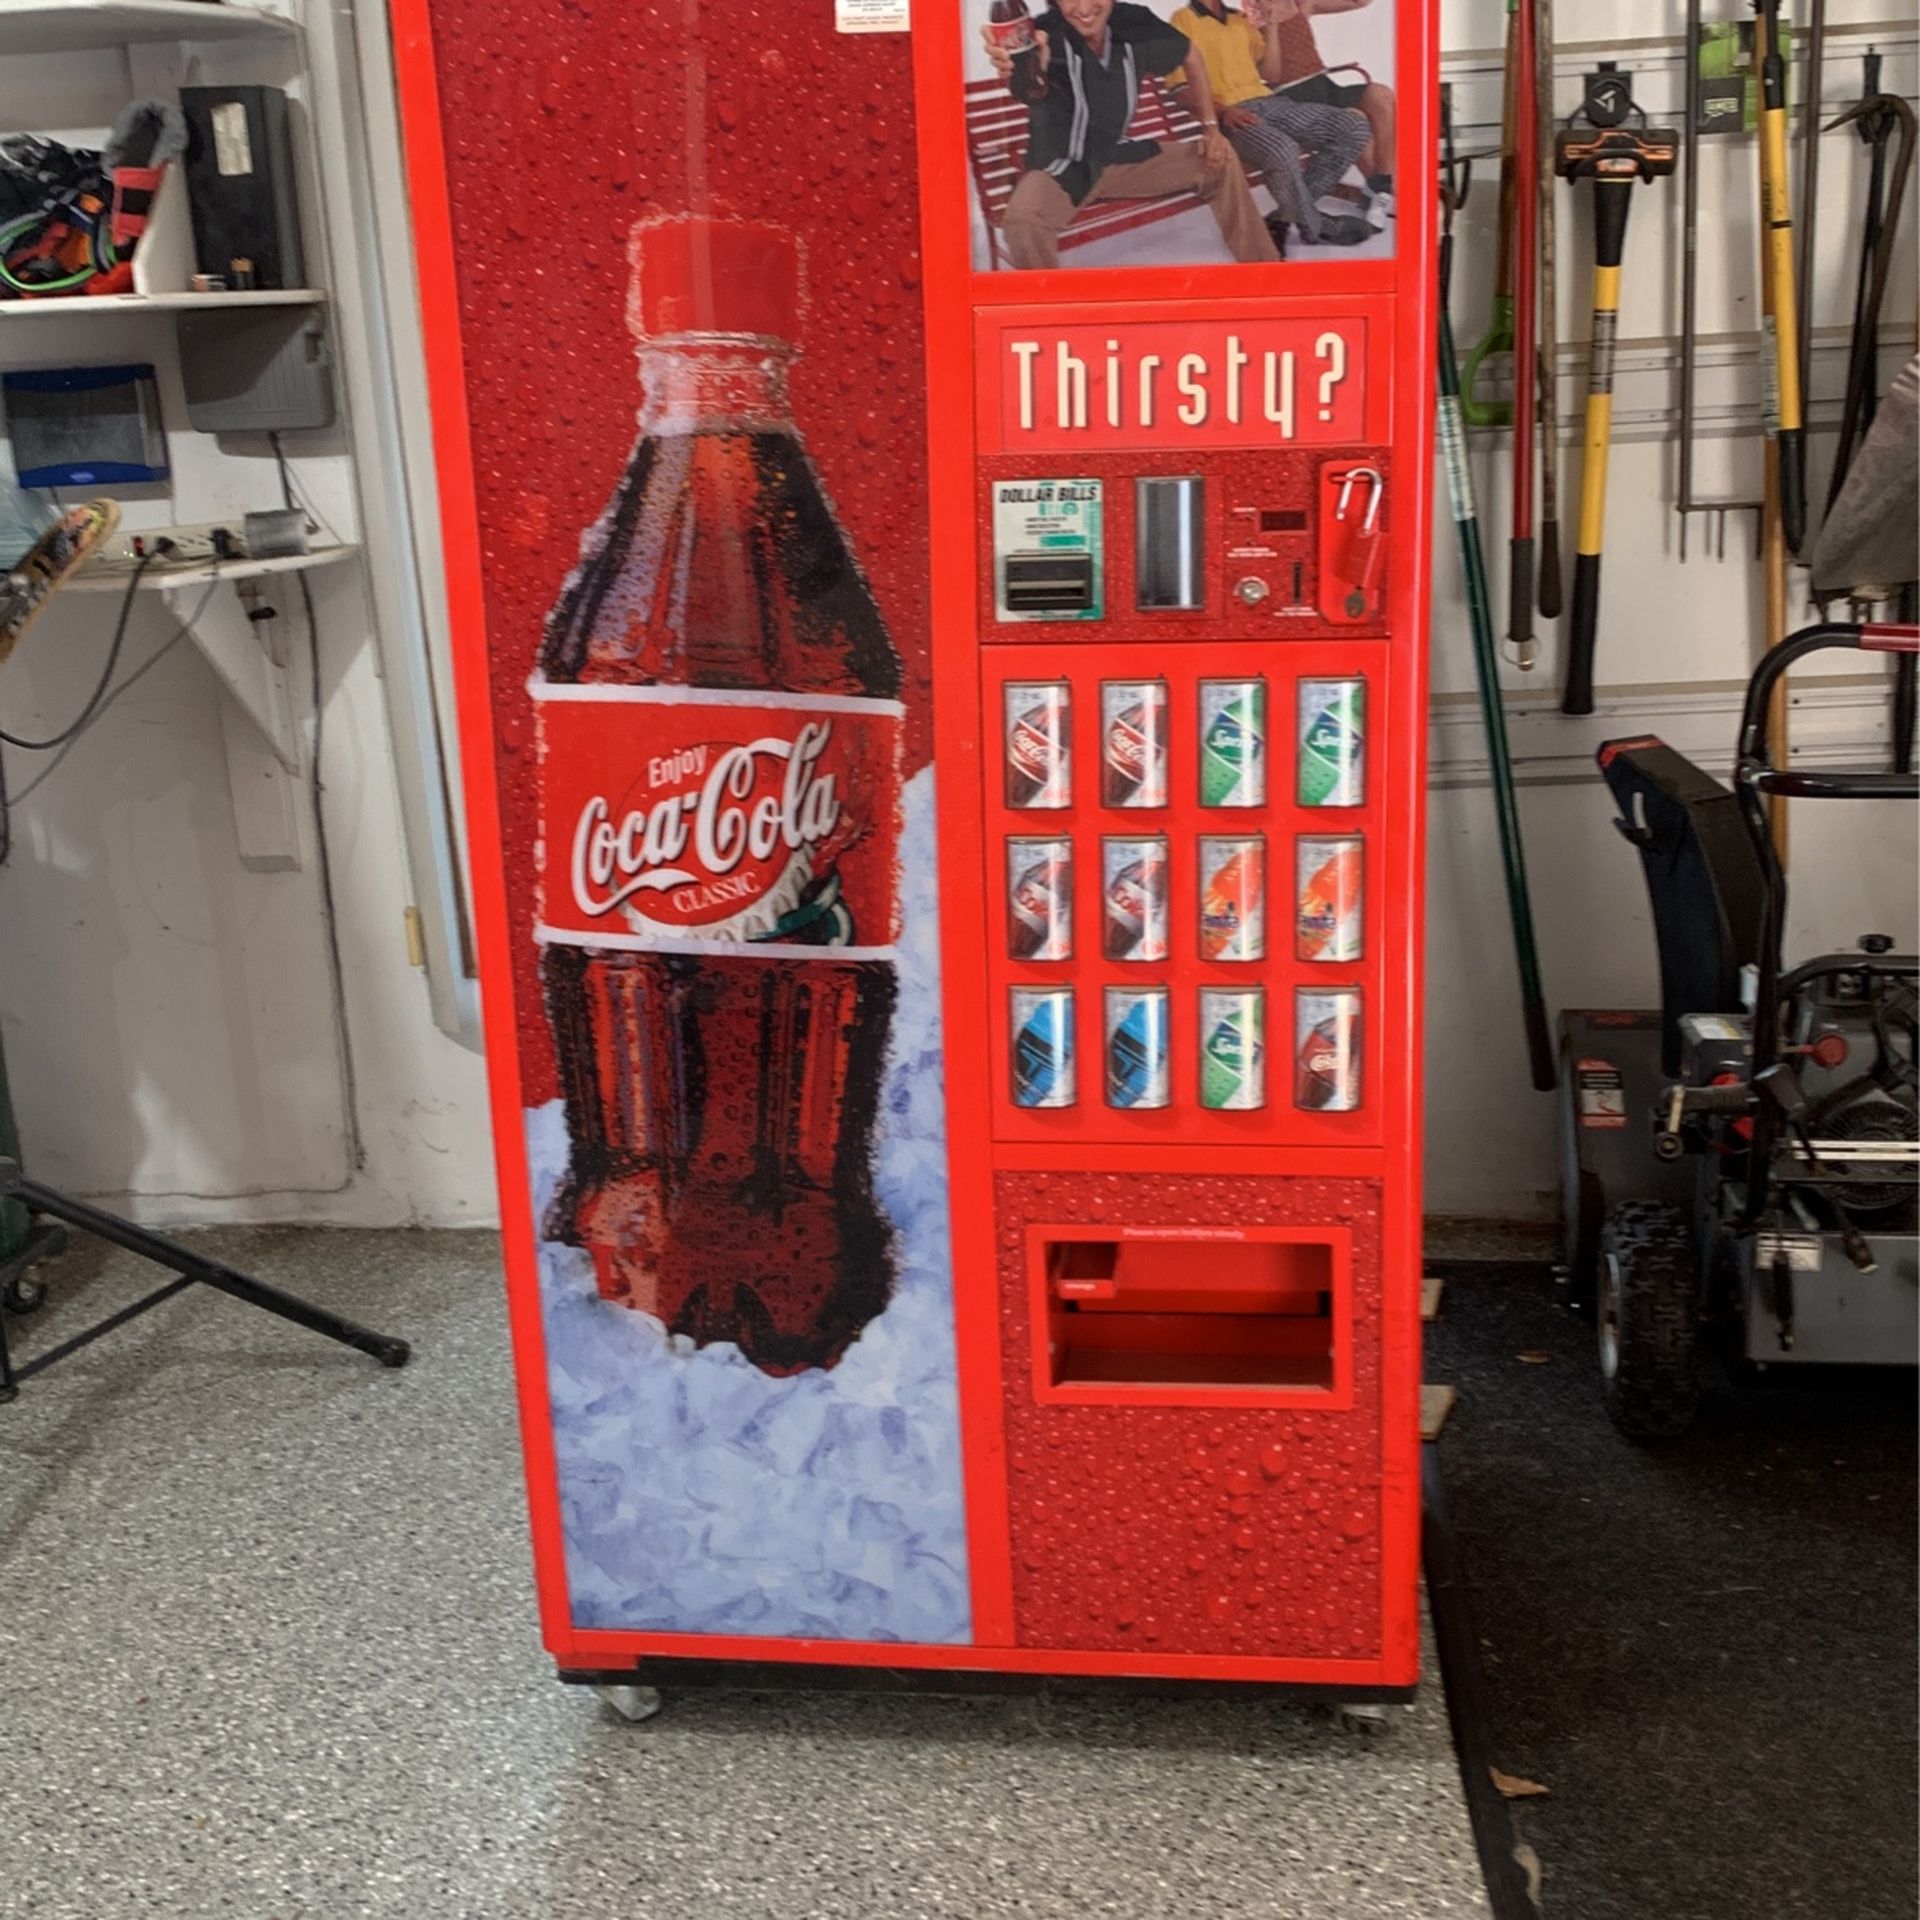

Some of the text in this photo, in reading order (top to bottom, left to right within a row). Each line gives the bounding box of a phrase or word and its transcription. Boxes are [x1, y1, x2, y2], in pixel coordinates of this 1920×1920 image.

[1011, 332, 1345, 438] Thirsty?
[999, 486, 1096, 503] DOLLAR BILLS
[649, 745, 707, 788] Enjoy
[571, 718, 839, 915] Coca-Cola
[673, 872, 761, 913] CLASSIC
